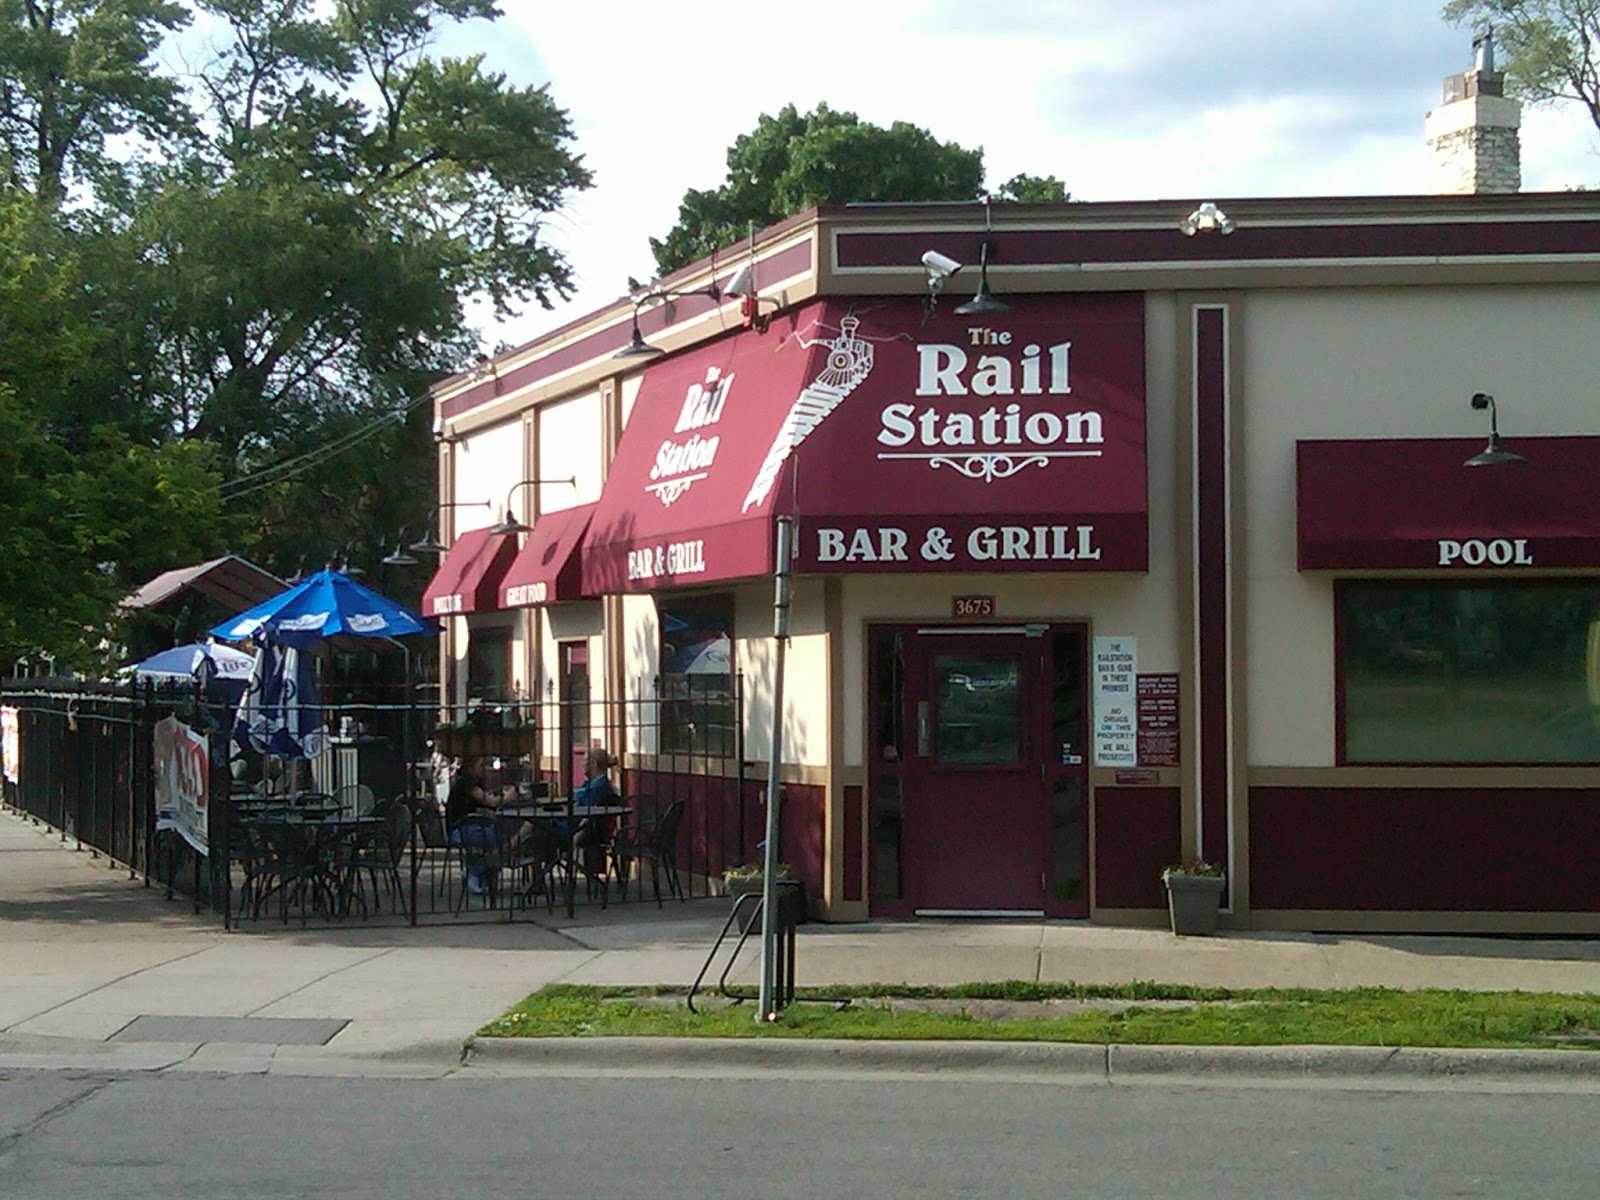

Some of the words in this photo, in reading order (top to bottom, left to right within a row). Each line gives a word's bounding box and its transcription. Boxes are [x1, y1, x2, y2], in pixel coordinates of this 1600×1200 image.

[968, 327, 1012, 346] The
[915, 342, 1072, 396] Rail
[674, 372, 735, 433] Rail
[877, 403, 1104, 446] Station
[650, 434, 720, 480] Station
[628, 548, 653, 580] BAR
[654, 546, 665, 577] &
[667, 539, 705, 575] GRILL
[817, 528, 909, 562] BAR
[920, 526, 956, 561] &
[967, 525, 1101, 560] GRILL
[1438, 539, 1533, 565] POOL
[956, 599, 991, 615] 3675
[1097, 732, 1134, 740] PROPERTY
[1103, 743, 1113, 751] WE
